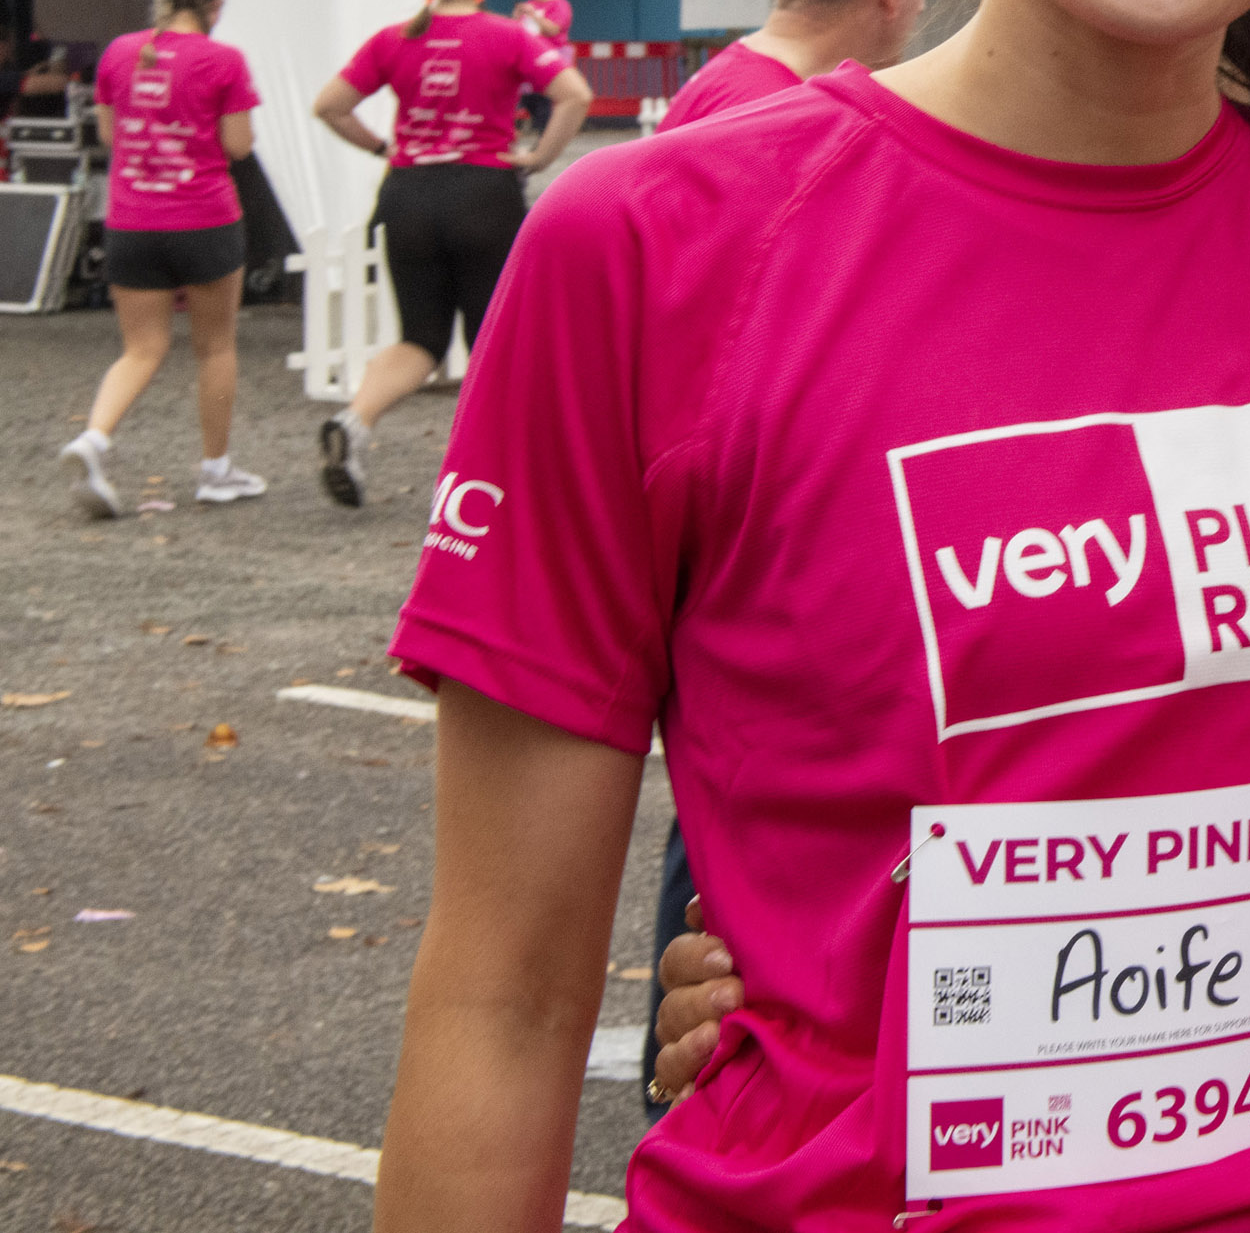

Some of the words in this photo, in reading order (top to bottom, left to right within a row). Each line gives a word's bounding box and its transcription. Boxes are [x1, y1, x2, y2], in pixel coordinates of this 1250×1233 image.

[935, 513, 1146, 609] very
[956, 831, 1130, 886] VERY
[1050, 922, 1244, 1023] Aoife
[933, 1120, 1001, 1149] very
[1011, 1115, 1071, 1139] PINK
[1010, 1136, 1064, 1161] RUN
